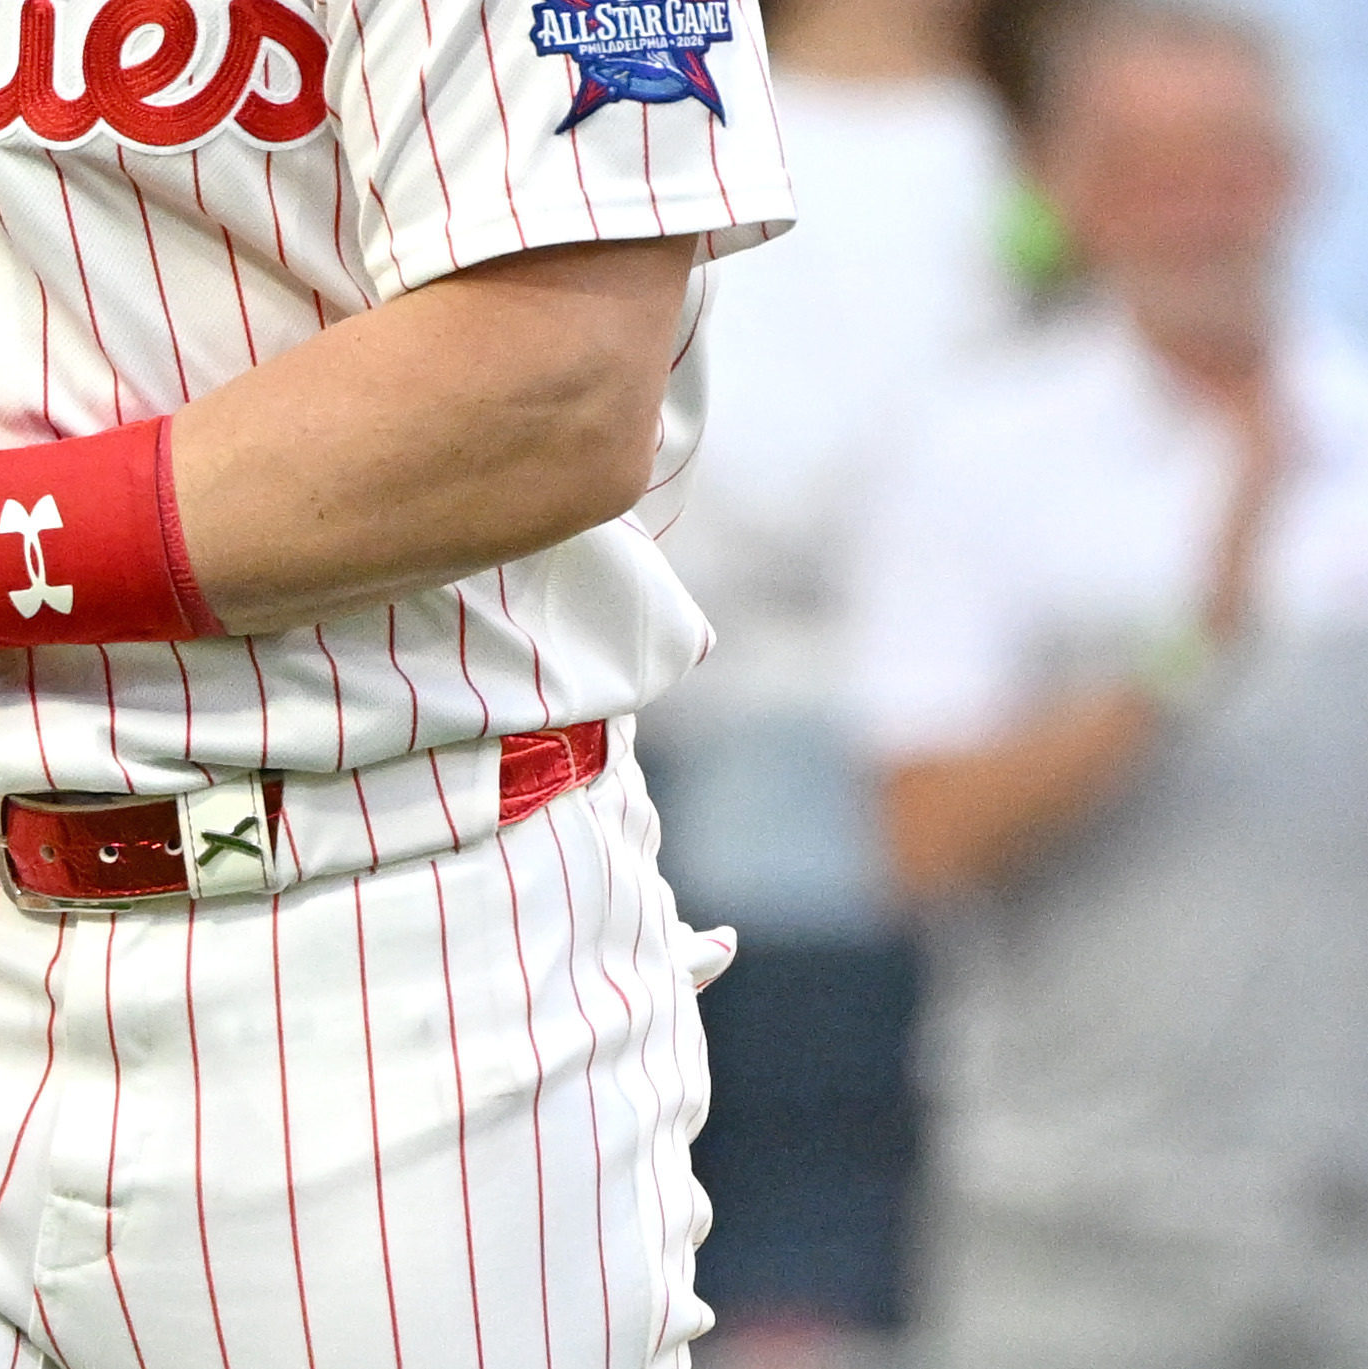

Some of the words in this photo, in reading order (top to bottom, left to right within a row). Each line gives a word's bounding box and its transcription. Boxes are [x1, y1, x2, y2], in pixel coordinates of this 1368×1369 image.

[537, 10, 595, 47] ALL
[595, 3, 665, 41] STAR
[579, 36, 669, 56] PHILADELPHIA
[676, 35, 705, 48] 2026
